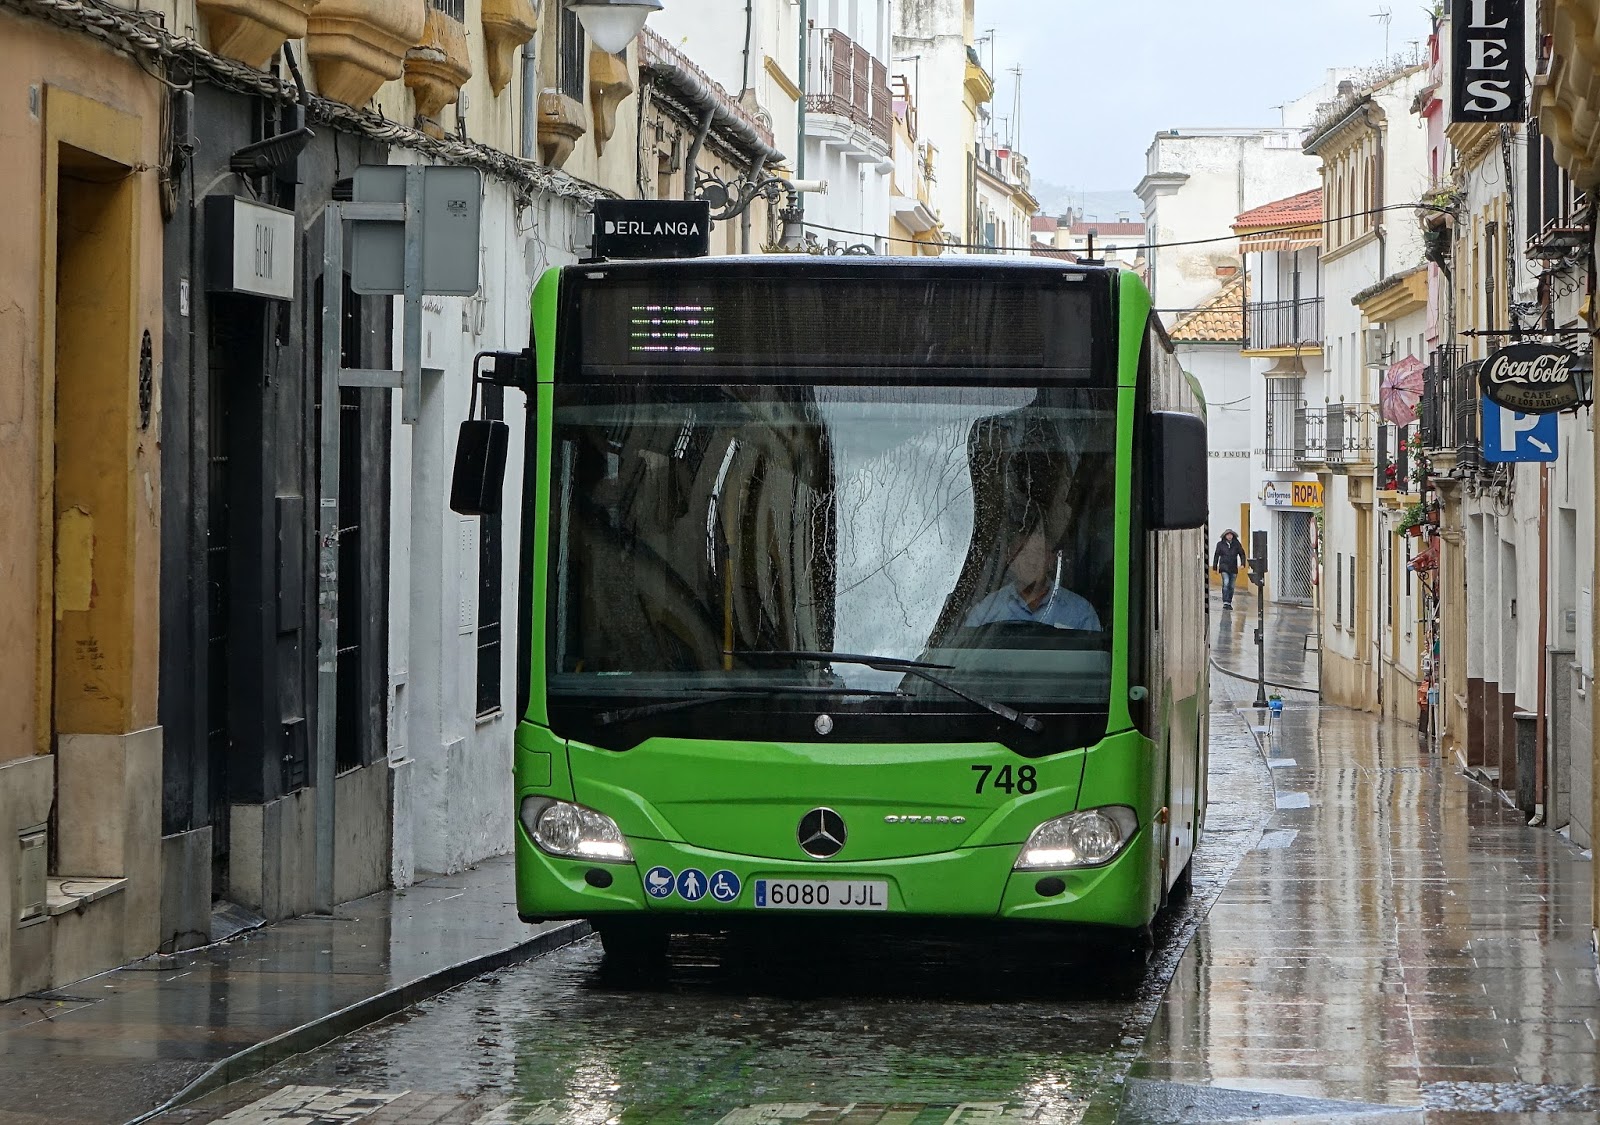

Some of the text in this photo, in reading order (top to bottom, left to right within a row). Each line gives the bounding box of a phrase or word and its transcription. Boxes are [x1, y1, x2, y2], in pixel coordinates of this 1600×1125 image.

[604, 221, 700, 235] BERLANGA
[1490, 354, 1571, 383] Coca-Cola
[1505, 394, 1571, 407] DE LOS FAROLES
[1266, 491, 1291, 499] Uniformes
[1294, 485, 1318, 503] ROPA
[971, 765, 1038, 794] 748
[884, 814, 966, 824] CITARO
[771, 883, 830, 905] 6080
[839, 884, 882, 906] JJL
